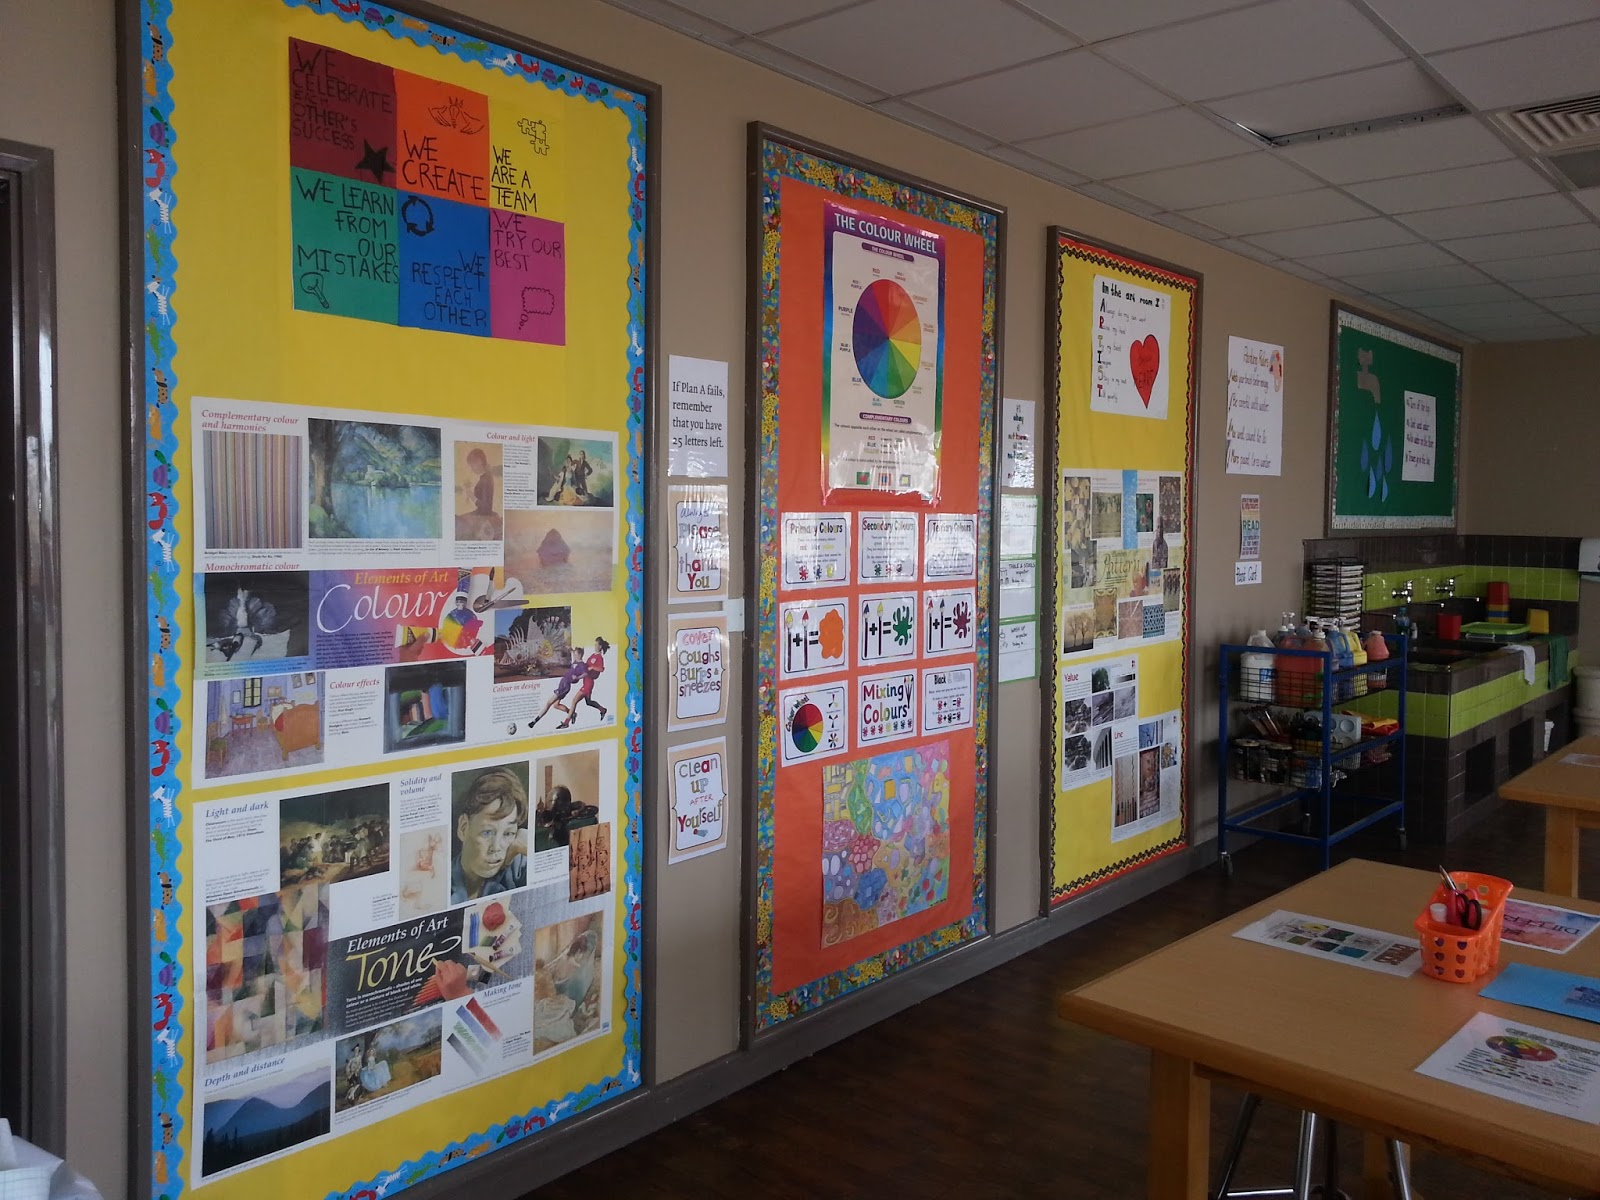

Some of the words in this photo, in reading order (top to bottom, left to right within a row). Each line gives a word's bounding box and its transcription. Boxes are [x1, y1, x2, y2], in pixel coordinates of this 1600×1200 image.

[294, 42, 335, 74] WE
[292, 69, 393, 113] CELEBRATE
[292, 102, 358, 133] OTHER'S
[292, 121, 355, 150] SUCCESS
[403, 130, 438, 162] WE
[492, 145, 512, 166] WE
[402, 160, 488, 201] CREATE
[491, 167, 518, 186] ARE
[521, 170, 532, 190] A
[295, 175, 335, 204] WE
[342, 182, 395, 217] LEARN
[491, 185, 538, 213] TEAM
[335, 210, 388, 240] FROM
[492, 210, 527, 234] WE
[834, 212, 856, 231] THE
[858, 220, 901, 244] COLOUR
[904, 232, 937, 254] WHEEL
[357, 238, 397, 264] OUR
[494, 229, 527, 251] TRY
[531, 237, 562, 259] OUR
[297, 245, 400, 284] MISTAKES
[459, 250, 486, 277] WE
[494, 249, 529, 272] BEST
[412, 261, 485, 292] RESPECT
[435, 287, 472, 307] EACH
[1110, 282, 1121, 298] the
[1126, 292, 1135, 303] art
[1139, 297, 1153, 306] room
[1155, 298, 1160, 307] I
[424, 302, 487, 327] OTHER
[838, 306, 853, 314] PURPLE
[672, 381, 681, 392] If
[681, 382, 698, 394] Plan
[700, 384, 706, 395] A
[707, 385, 725, 398] fails,
[201, 409, 272, 425] Complementary
[273, 414, 299, 425] colour
[672, 401, 712, 412] remember
[202, 420, 219, 429] and
[220, 421, 267, 432] harmonies
[672, 417, 689, 428] that
[690, 421, 704, 431] you
[705, 419, 722, 430] have
[863, 413, 893, 422] COMPLEMENTARY
[486, 432, 508, 442] Colour
[509, 434, 520, 442] and
[521, 435, 535, 443] light
[673, 437, 682, 448] 25
[684, 435, 708, 447] letters
[710, 437, 724, 448] left.
[862, 519, 893, 533] Secondary
[205, 562, 274, 572] Monochromatic
[274, 561, 300, 571] colour
[354, 571, 411, 585] Elements
[414, 571, 428, 586] of
[430, 570, 449, 583] Art
[687, 573, 710, 590] You
[316, 583, 449, 634] Colour
[679, 643, 720, 666] Coughs
[329, 680, 355, 690] Colour
[356, 678, 380, 690] effects
[680, 667, 712, 684] Burps
[934, 674, 947, 685] Black
[1064, 672, 1079, 683] Value
[492, 684, 512, 694] Colour
[513, 684, 519, 692] in
[520, 682, 541, 692] design
[679, 680, 721, 697] sneezes
[863, 683, 904, 702] Mixing
[863, 701, 908, 725] Colours
[400, 776, 428, 788] Solidity
[429, 773, 442, 783] and
[400, 785, 426, 796] volume
[205, 806, 229, 819] Light
[231, 804, 247, 815] and
[249, 801, 269, 812] dark
[690, 793, 713, 806] AFTER
[347, 927, 406, 953] Elements
[410, 920, 426, 938] of
[426, 916, 449, 932] Art
[345, 936, 462, 992] Tone
[483, 985, 508, 998] Making
[510, 981, 522, 992] tone
[204, 1071, 231, 1087] Depth
[233, 1067, 249, 1080] and
[251, 1057, 285, 1074] distance
